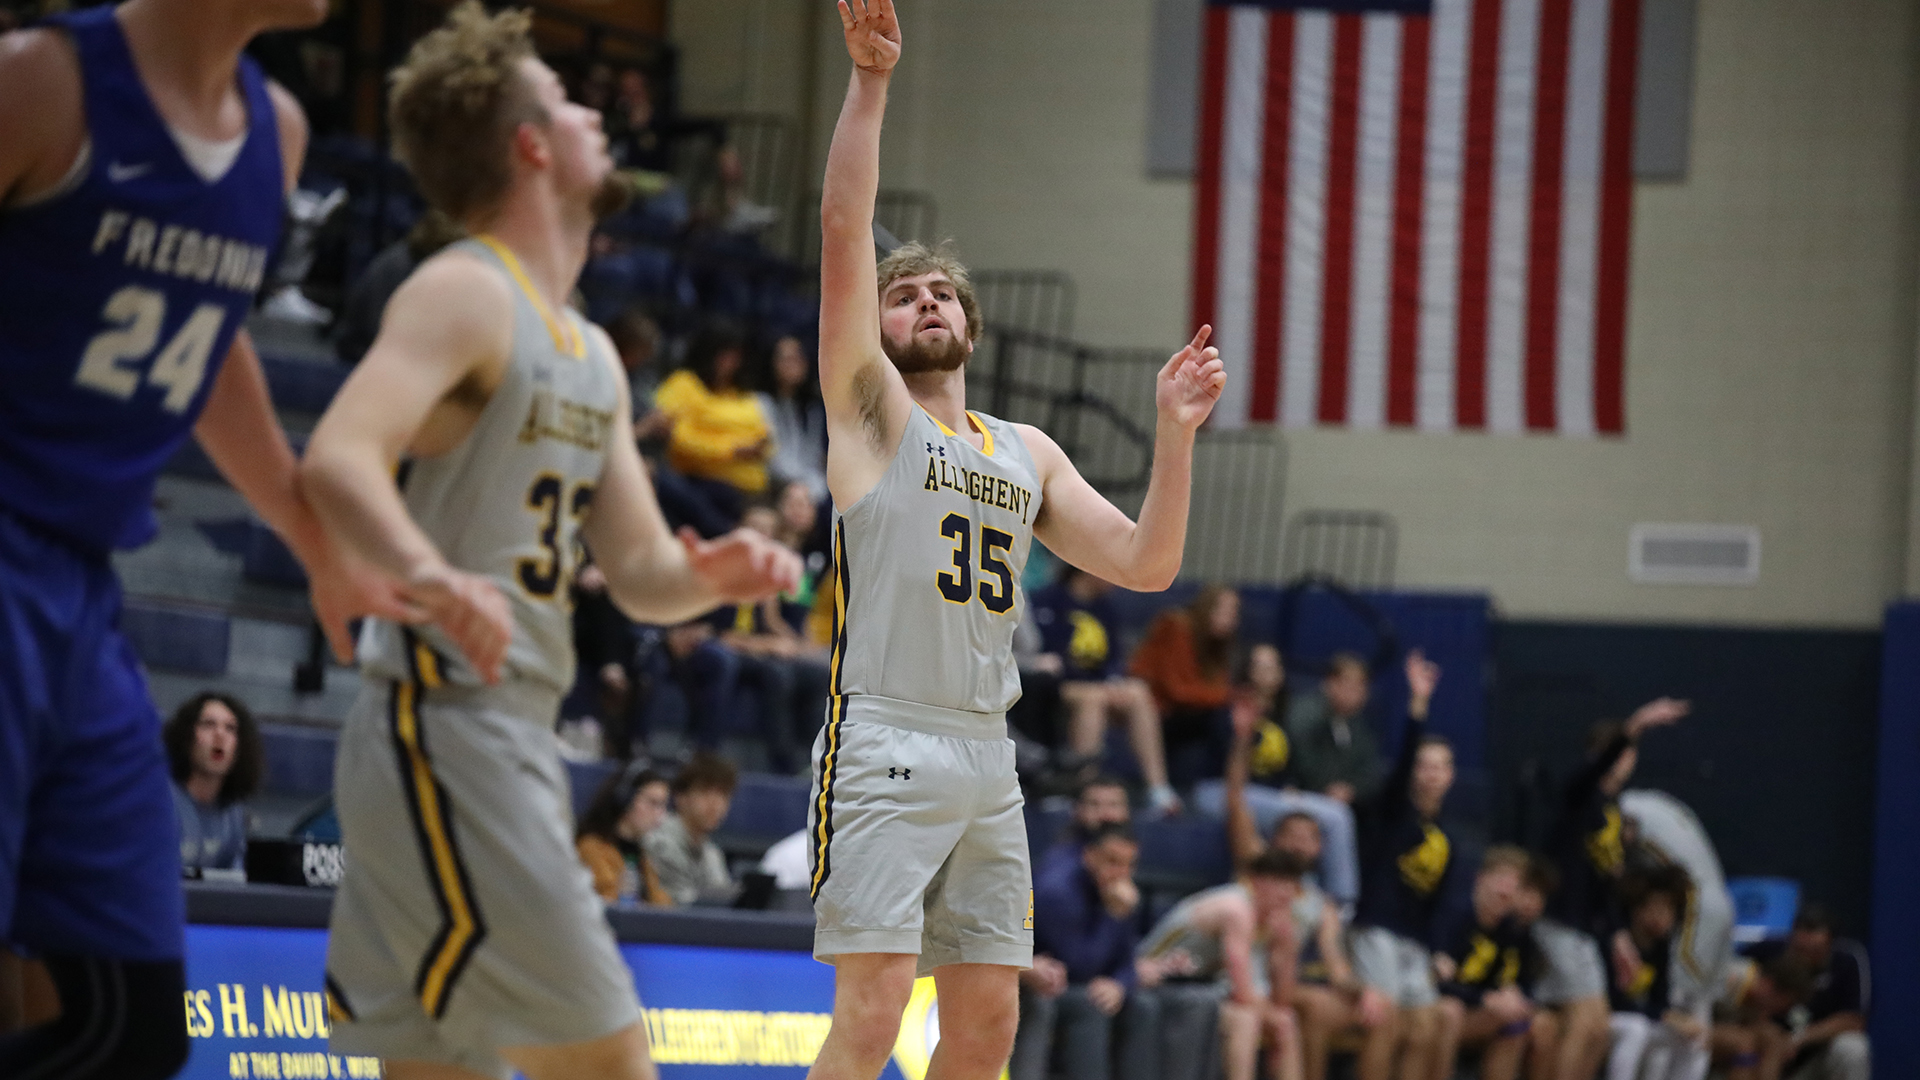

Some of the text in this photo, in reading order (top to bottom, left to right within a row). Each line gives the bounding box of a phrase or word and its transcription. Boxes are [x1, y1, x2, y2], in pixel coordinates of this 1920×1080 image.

[75, 284, 227, 414] 24
[935, 510, 1015, 615] 35
[217, 983, 259, 1038] H.
[262, 984, 332, 1039] MUL
